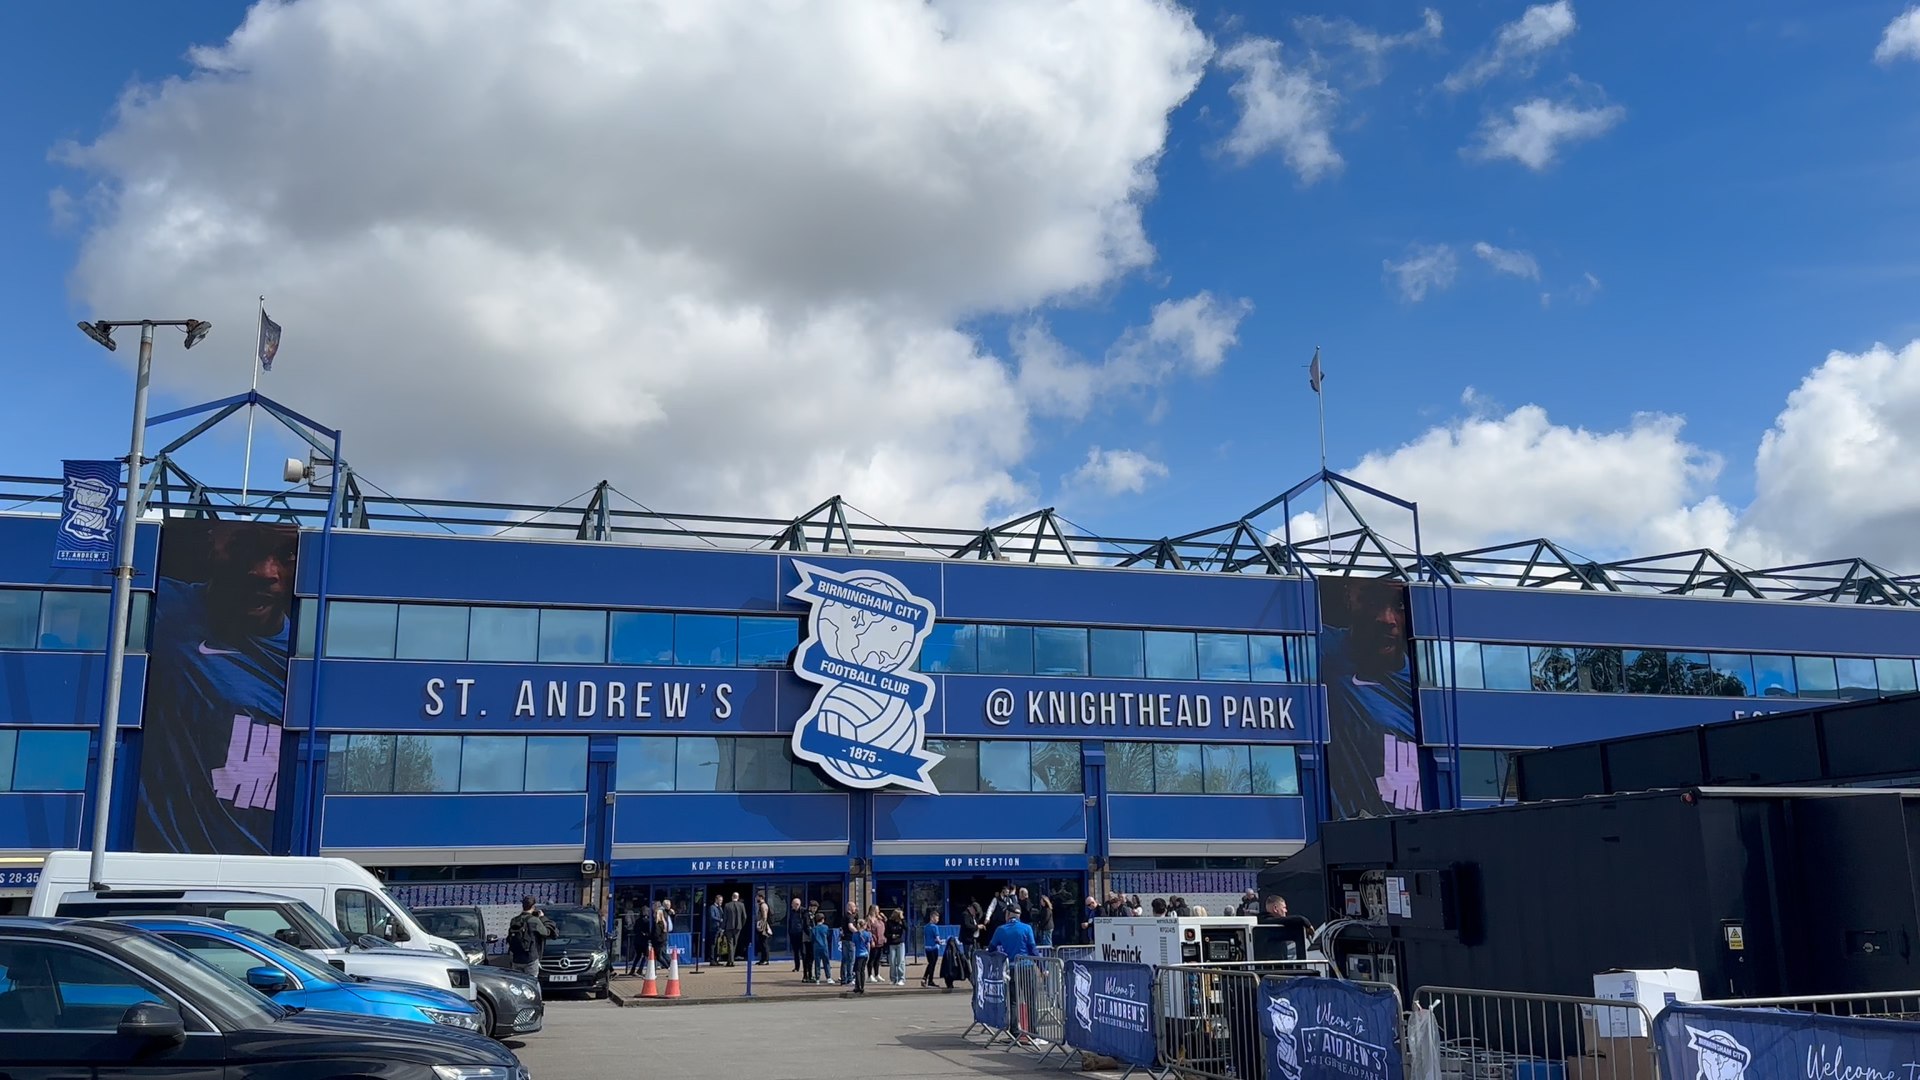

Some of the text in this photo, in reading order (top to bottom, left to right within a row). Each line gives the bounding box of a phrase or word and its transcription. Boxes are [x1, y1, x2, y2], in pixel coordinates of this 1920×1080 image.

[817, 580, 922, 621] BIRMINGHAM CITY
[820, 659, 910, 695] FOOTBALL CLUB
[425, 678, 733, 719] ST. ANDREW'S
[985, 688, 1295, 729] @ KNIGHTHEAD PARK
[691, 860, 775, 871] KOP RECEPTION
[945, 857, 1020, 867] KOP RECEPTION
[9, 872, 40, 884] 28-35
[1102, 944, 1142, 963] Wernick
[1105, 976, 1128, 995] Welcome
[1097, 998, 1145, 1023] ST. ANDREW'S
[1806, 1043, 1901, 1080] Welcome
